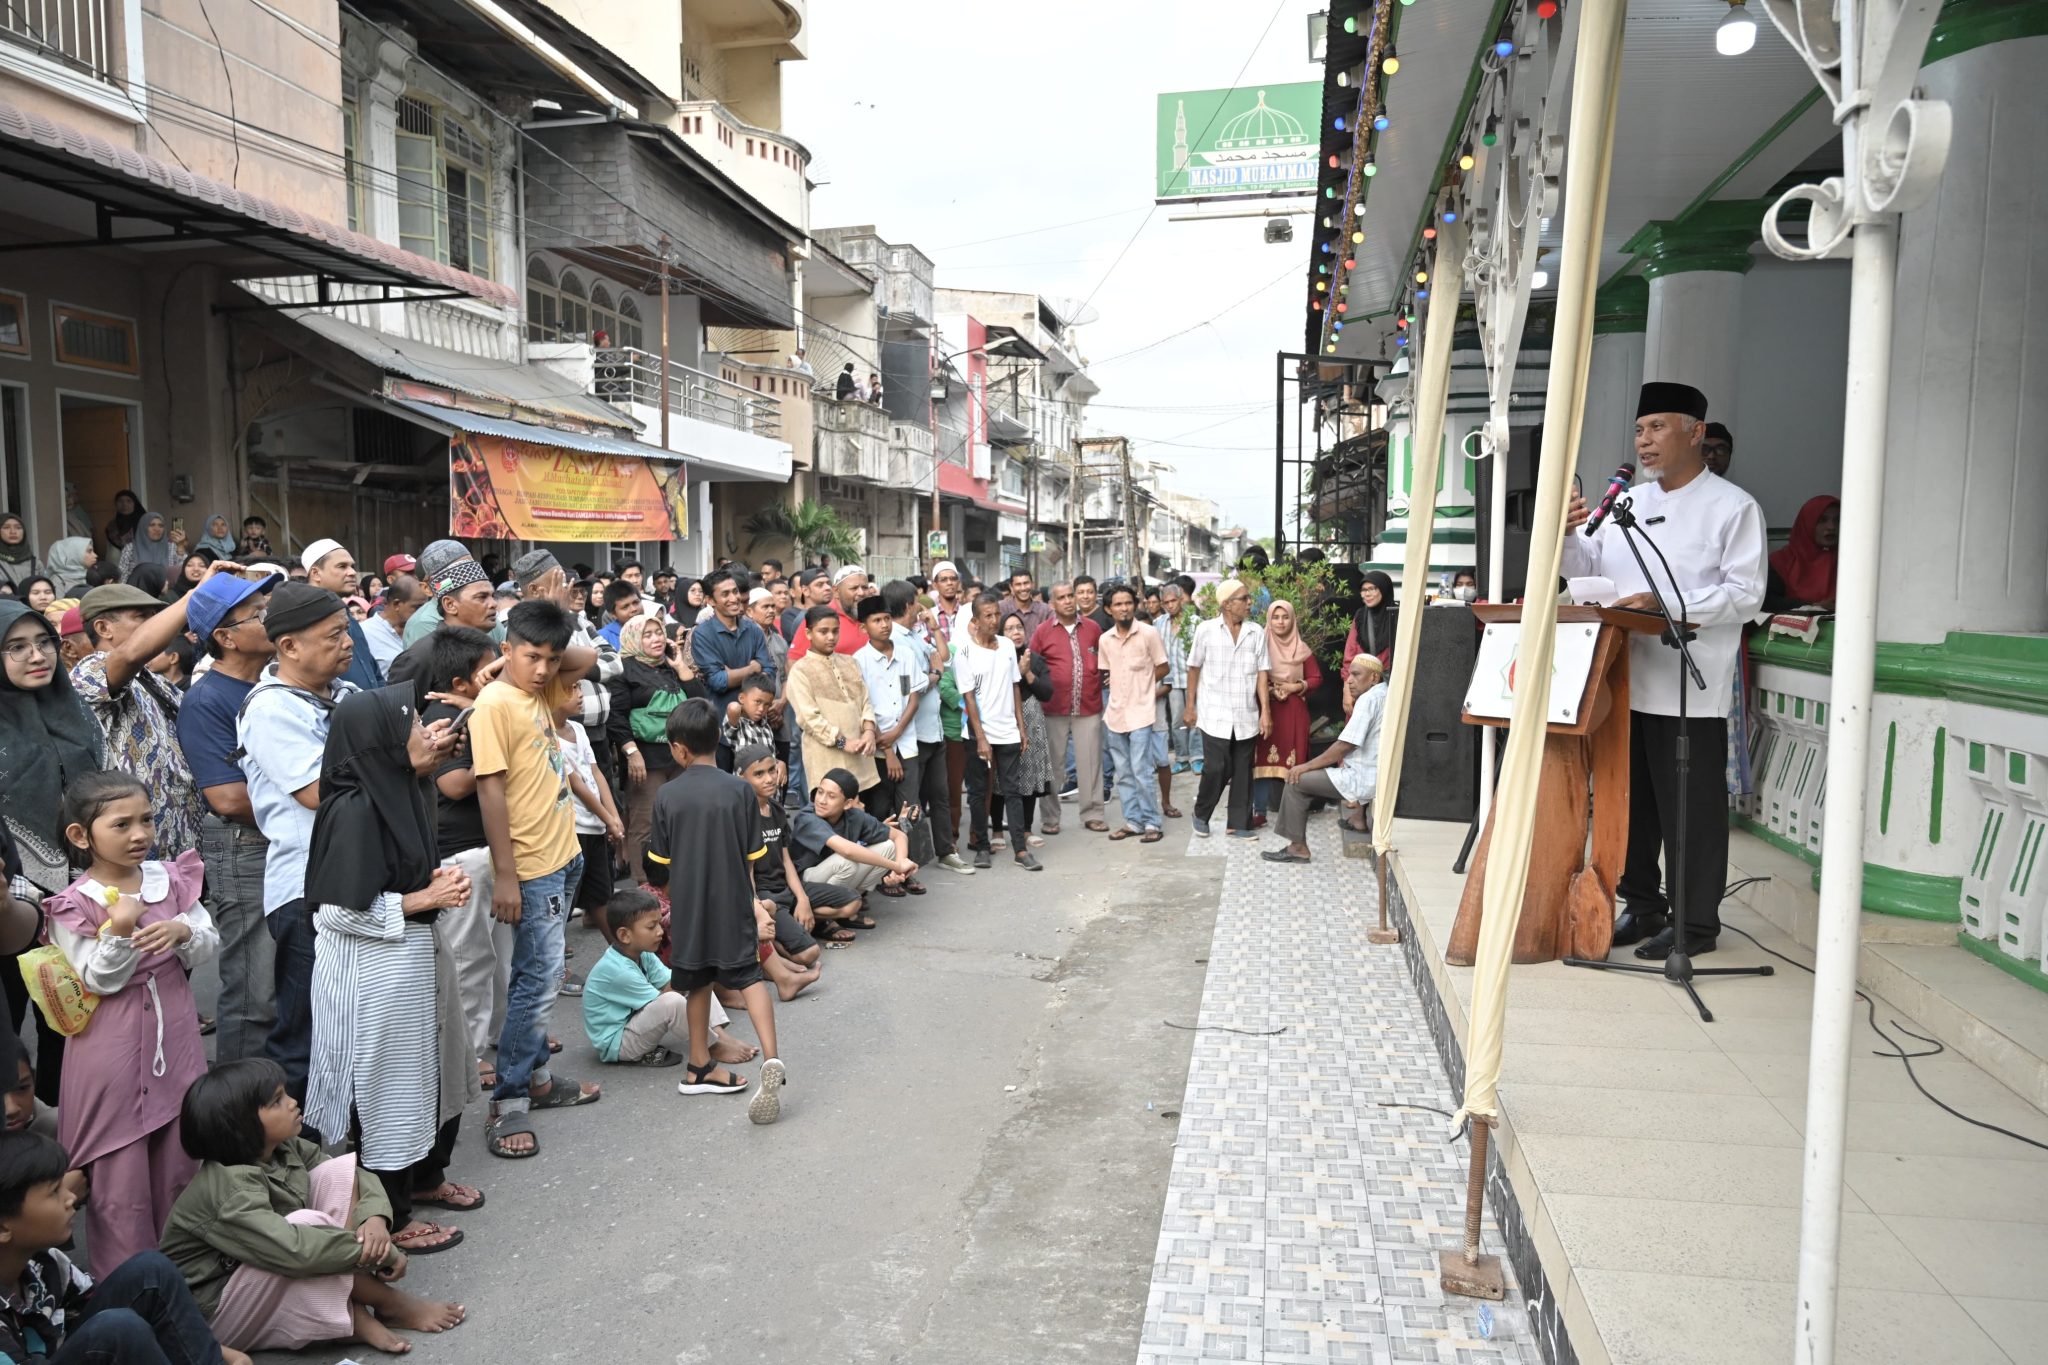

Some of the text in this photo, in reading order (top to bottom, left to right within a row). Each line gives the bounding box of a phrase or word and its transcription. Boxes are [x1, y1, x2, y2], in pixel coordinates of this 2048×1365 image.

[1262, 151, 1307, 161] مسجد
[1191, 168, 1238, 187] MASJID
[1259, 181, 1284, 191] Padang
